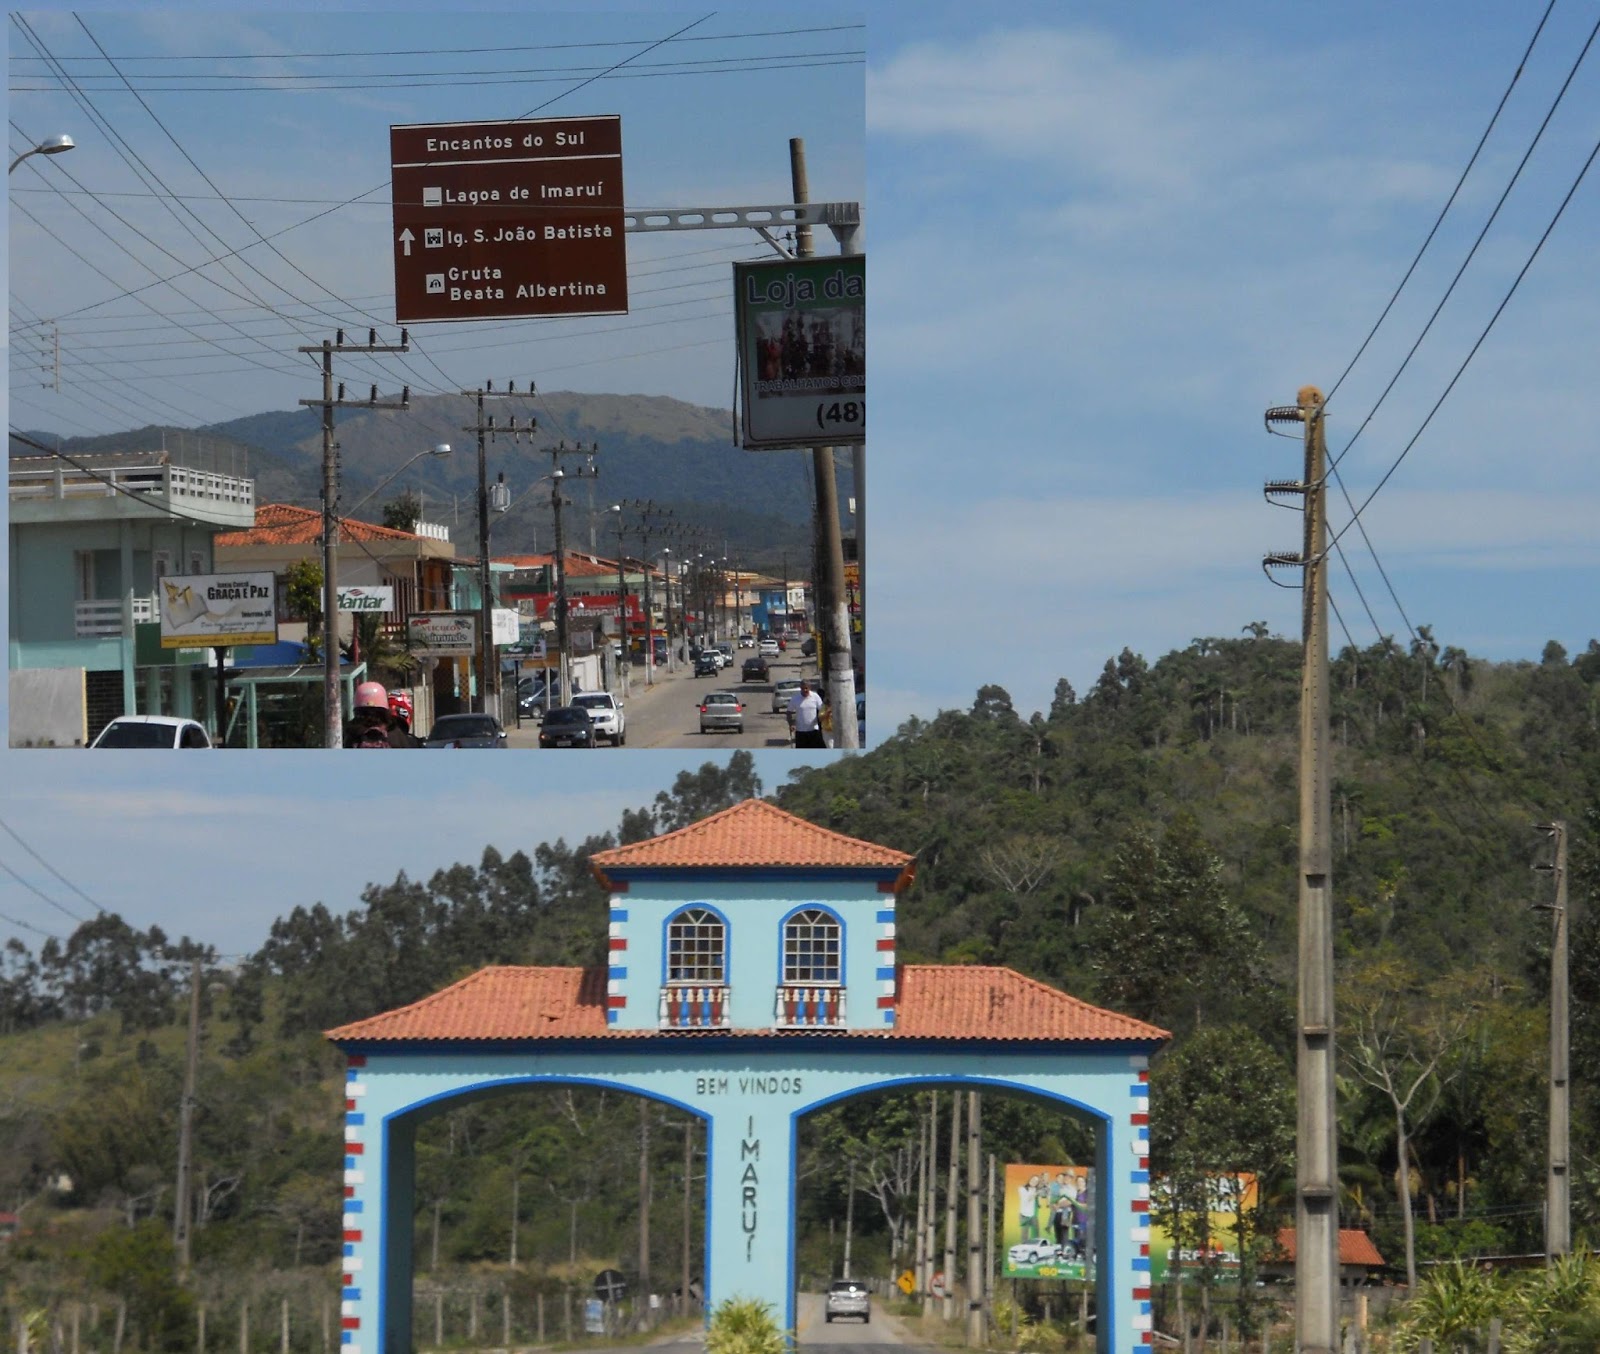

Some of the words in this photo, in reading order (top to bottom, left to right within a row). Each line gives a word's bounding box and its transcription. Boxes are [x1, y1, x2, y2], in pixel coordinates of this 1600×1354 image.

[426, 136, 513, 152] Encantos
[522, 133, 544, 147] do
[555, 131, 585, 146] Sul
[445, 189, 500, 205] Lagoa
[509, 186, 529, 200] de
[541, 181, 604, 198] Imaruí
[447, 231, 468, 247] Ig.
[473, 229, 489, 243] S.
[493, 226, 536, 242] João
[544, 224, 613, 240] Batista
[448, 266, 502, 281] Gruta
[450, 286, 504, 301] Beata
[516, 282, 606, 299] Albertina
[748, 273, 816, 309] Loja
[824, 269, 865, 300] da
[753, 376, 840, 392] TRABALHAMOS
[207, 586, 241, 601] GRAÇA
[250, 585, 269, 598] PAZ
[696, 1077, 728, 1095] BEM
[739, 1077, 803, 1095] VINDOS
